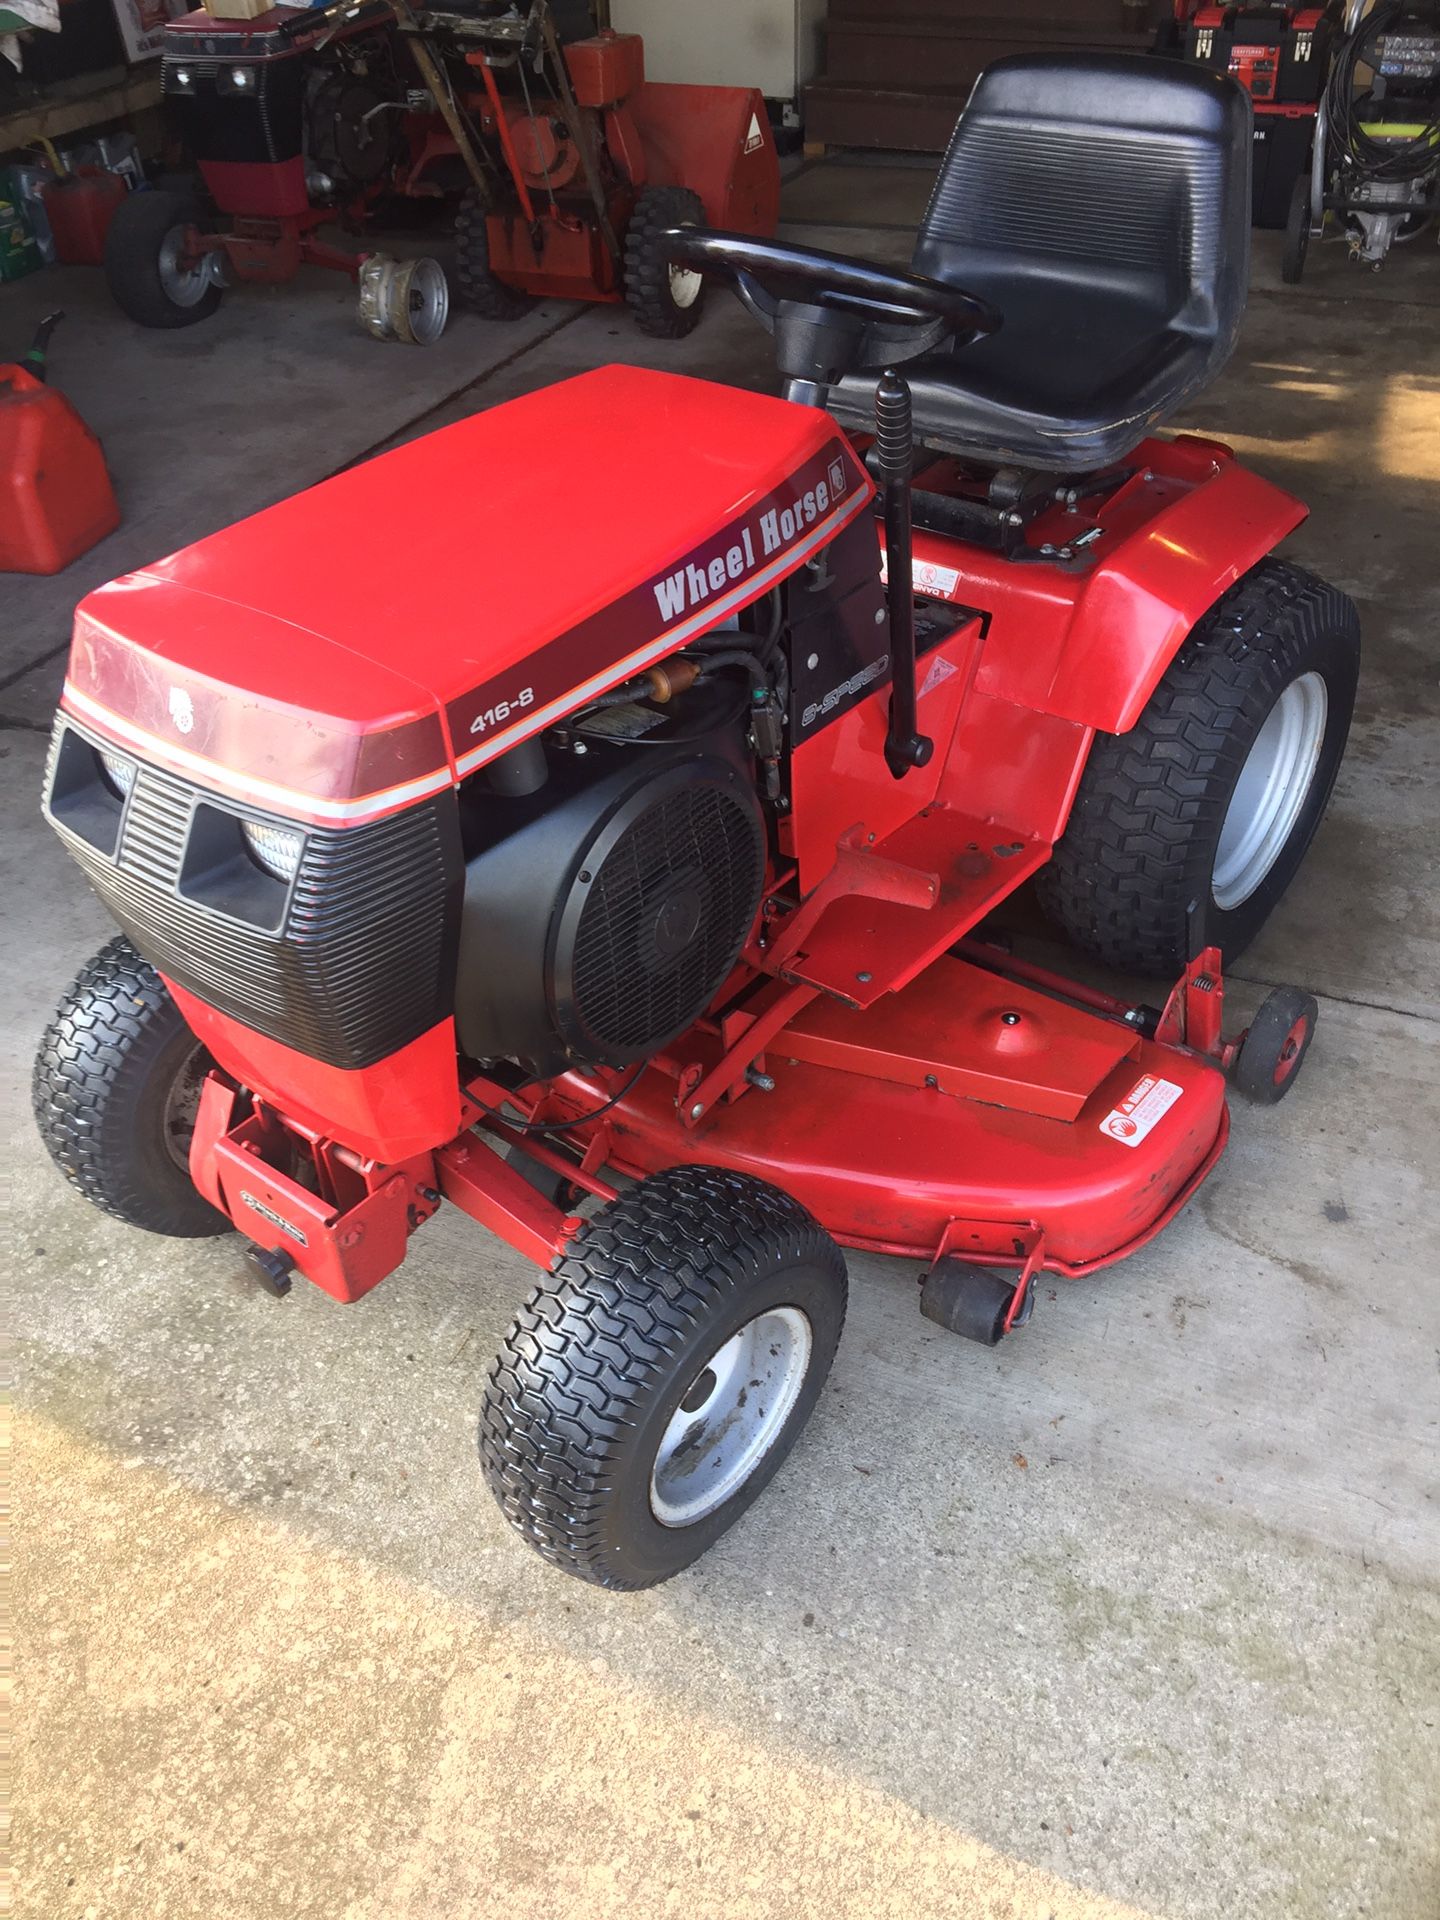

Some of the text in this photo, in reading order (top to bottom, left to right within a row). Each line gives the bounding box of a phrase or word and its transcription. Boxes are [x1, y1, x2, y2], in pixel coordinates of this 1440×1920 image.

[653, 480, 829, 622] Wheel Horse
[912, 583, 940, 596] DANG
[469, 687, 534, 734] 416-8
[801, 654, 889, 727] 8-SPEED
